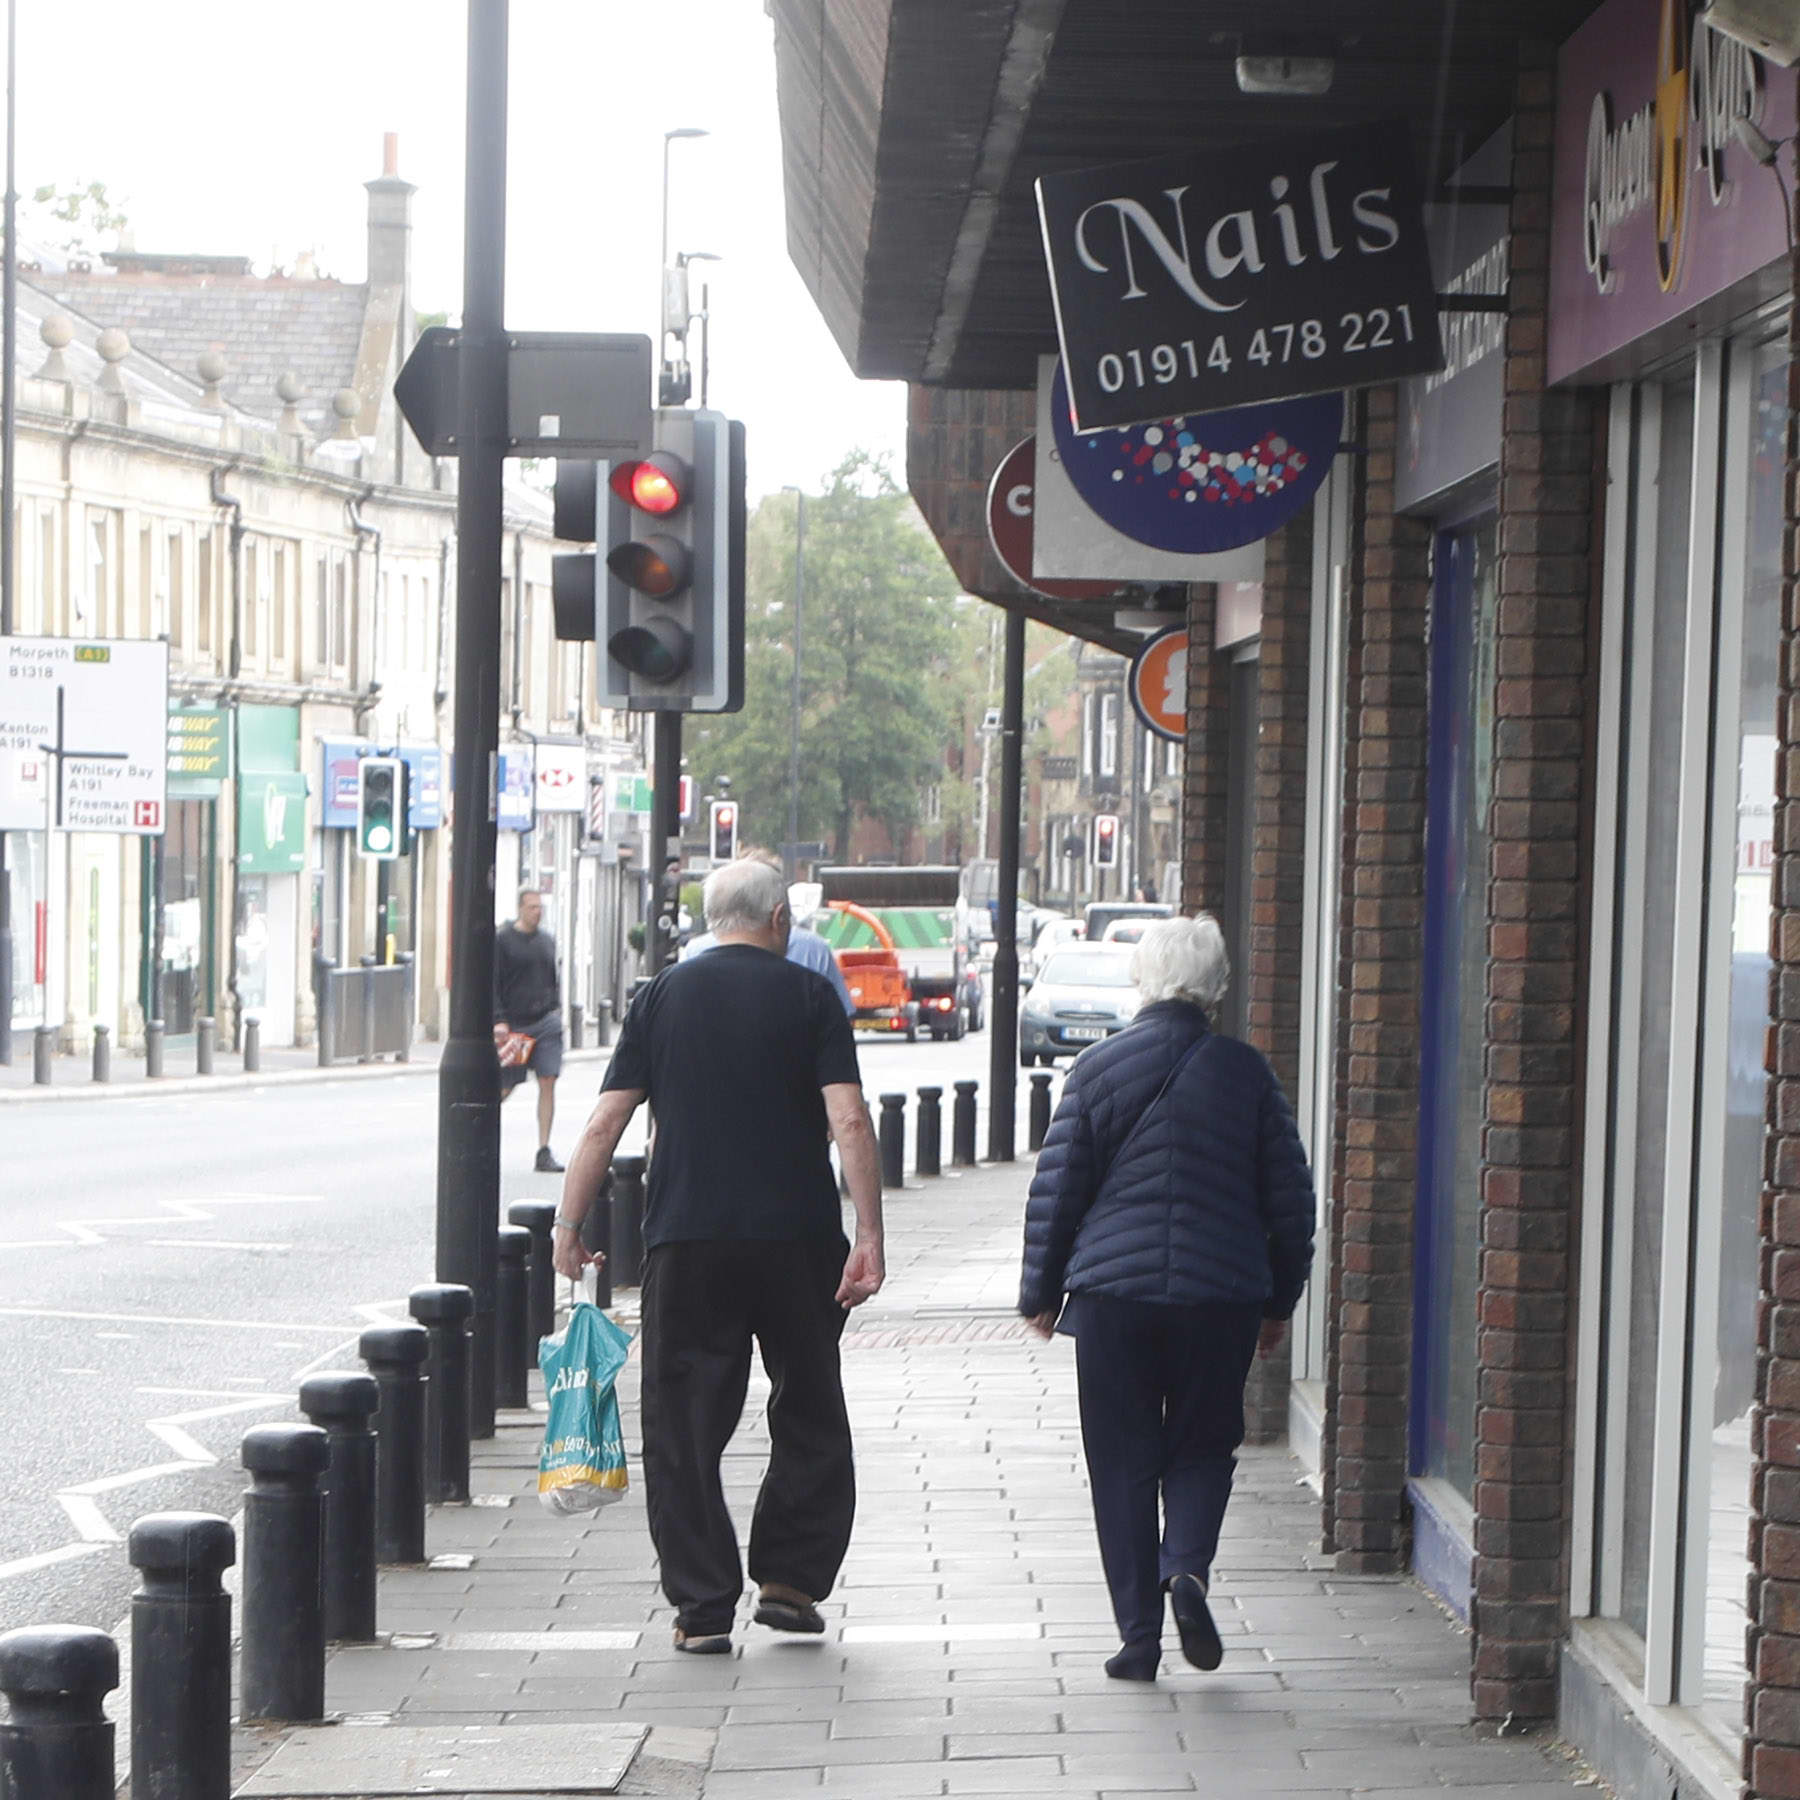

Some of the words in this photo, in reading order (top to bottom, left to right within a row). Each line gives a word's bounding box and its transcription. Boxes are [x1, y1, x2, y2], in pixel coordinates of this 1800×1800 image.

[1074, 160, 1401, 313] Nails
[1098, 333, 1232, 394] 01914
[1247, 320, 1327, 369] 478
[1340, 303, 1417, 356] 221
[9, 646, 69, 663] Morpeth
[76, 647, 109, 662] (A1)
[68, 764, 123, 779] Whitley
[127, 765, 154, 780] Bay
[68, 778, 103, 791] A191
[68, 797, 129, 810] Freeman
[68, 811, 128, 827] Hospital
